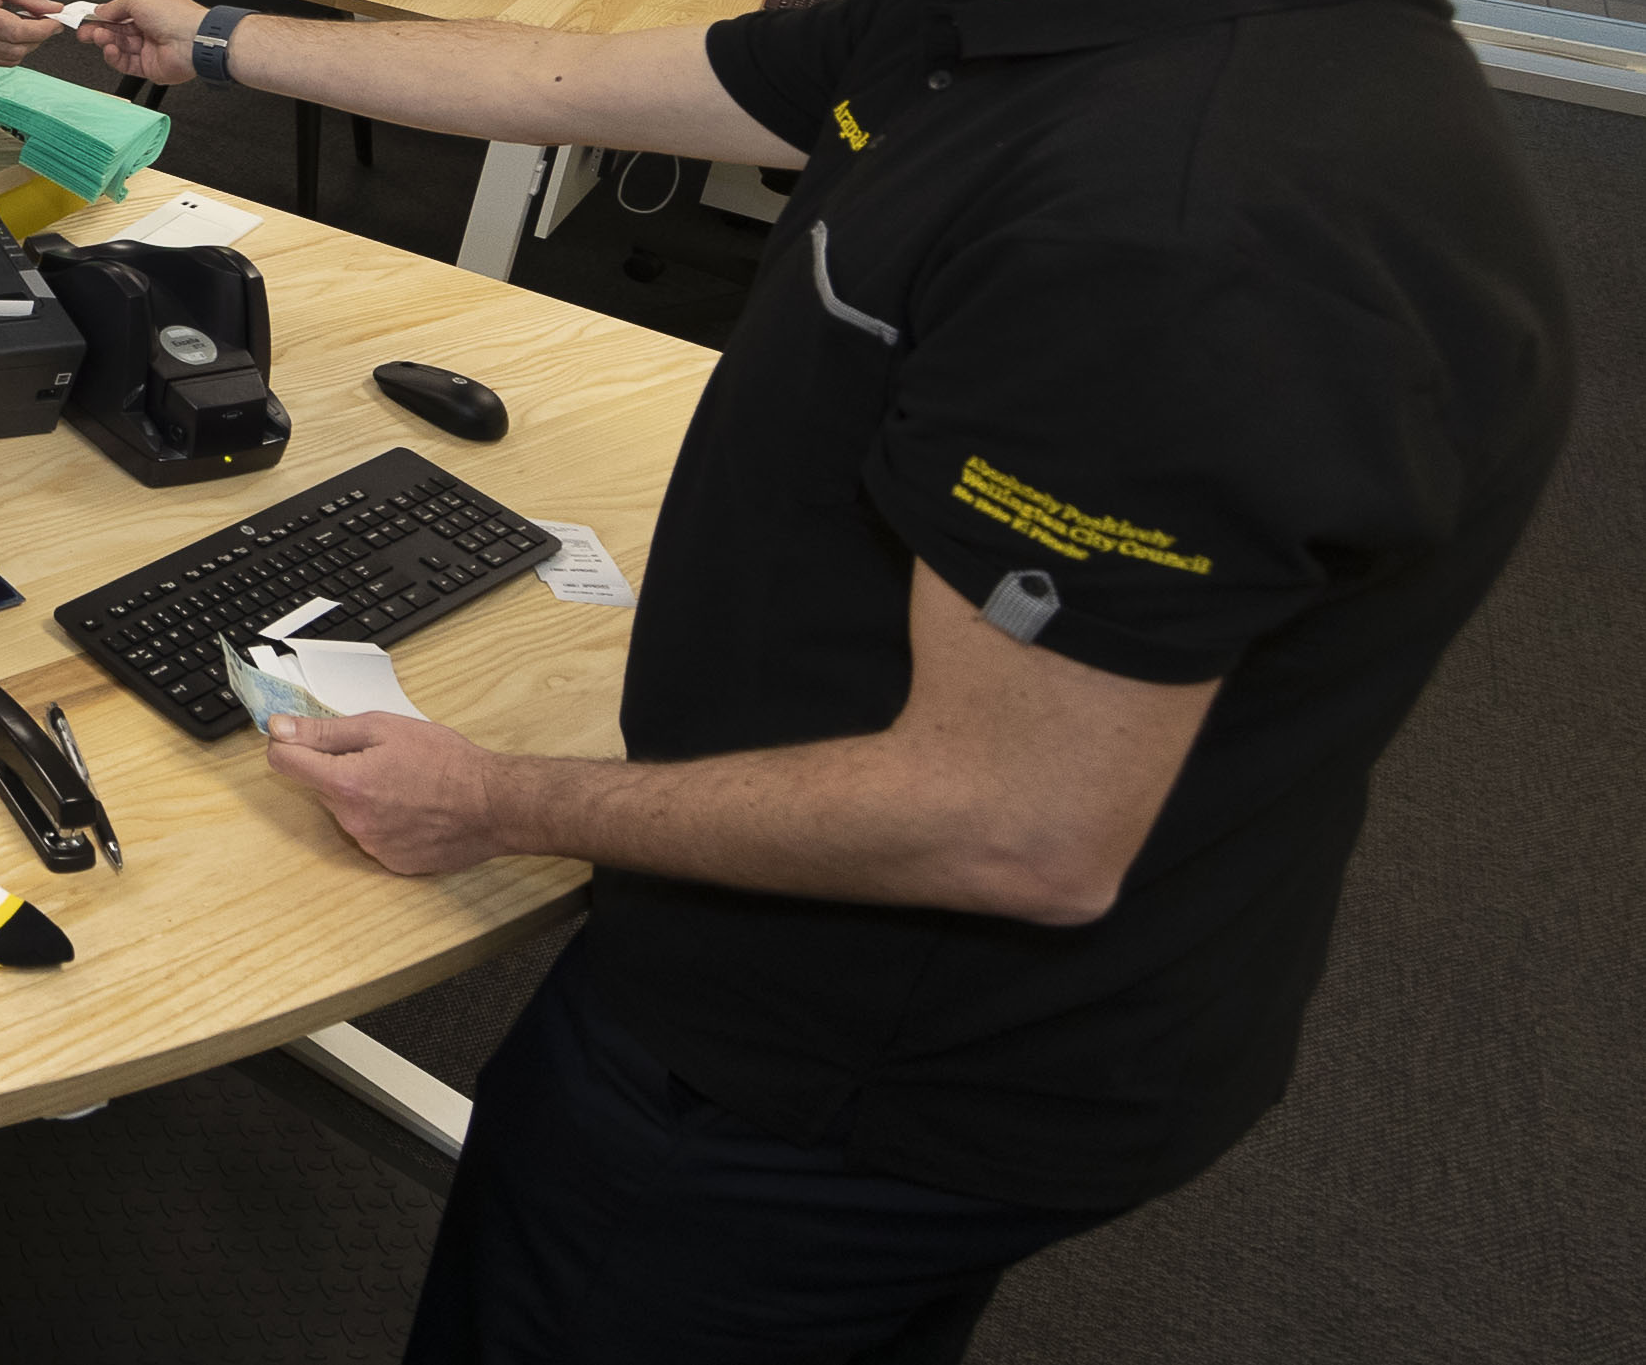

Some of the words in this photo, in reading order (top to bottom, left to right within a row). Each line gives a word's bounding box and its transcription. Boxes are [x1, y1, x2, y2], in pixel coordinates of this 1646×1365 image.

[962, 467, 1068, 535] Wellington
[1069, 527, 1118, 552] City
[1118, 540, 1212, 575] Council
[1061, 503, 1177, 548] Positively
